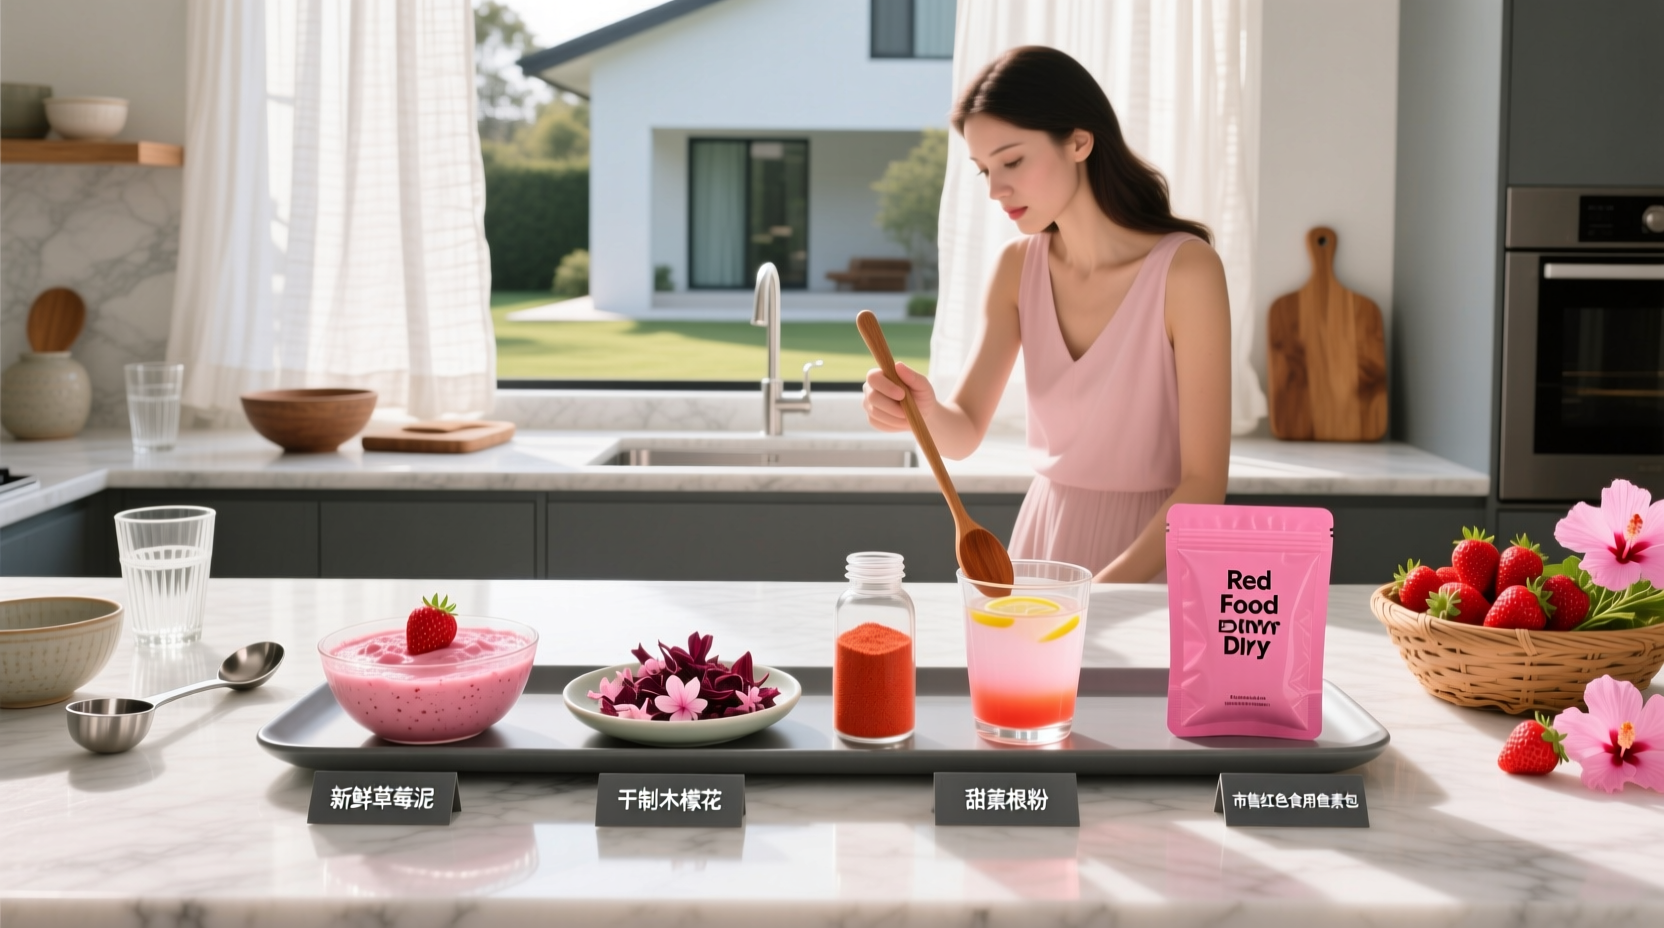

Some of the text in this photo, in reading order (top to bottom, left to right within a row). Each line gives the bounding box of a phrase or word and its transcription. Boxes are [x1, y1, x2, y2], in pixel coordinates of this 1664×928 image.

[1227, 569, 1272, 591] Red
[1220, 593, 1279, 615] Food
[329, 784, 435, 811] 新鲜草莓泥
